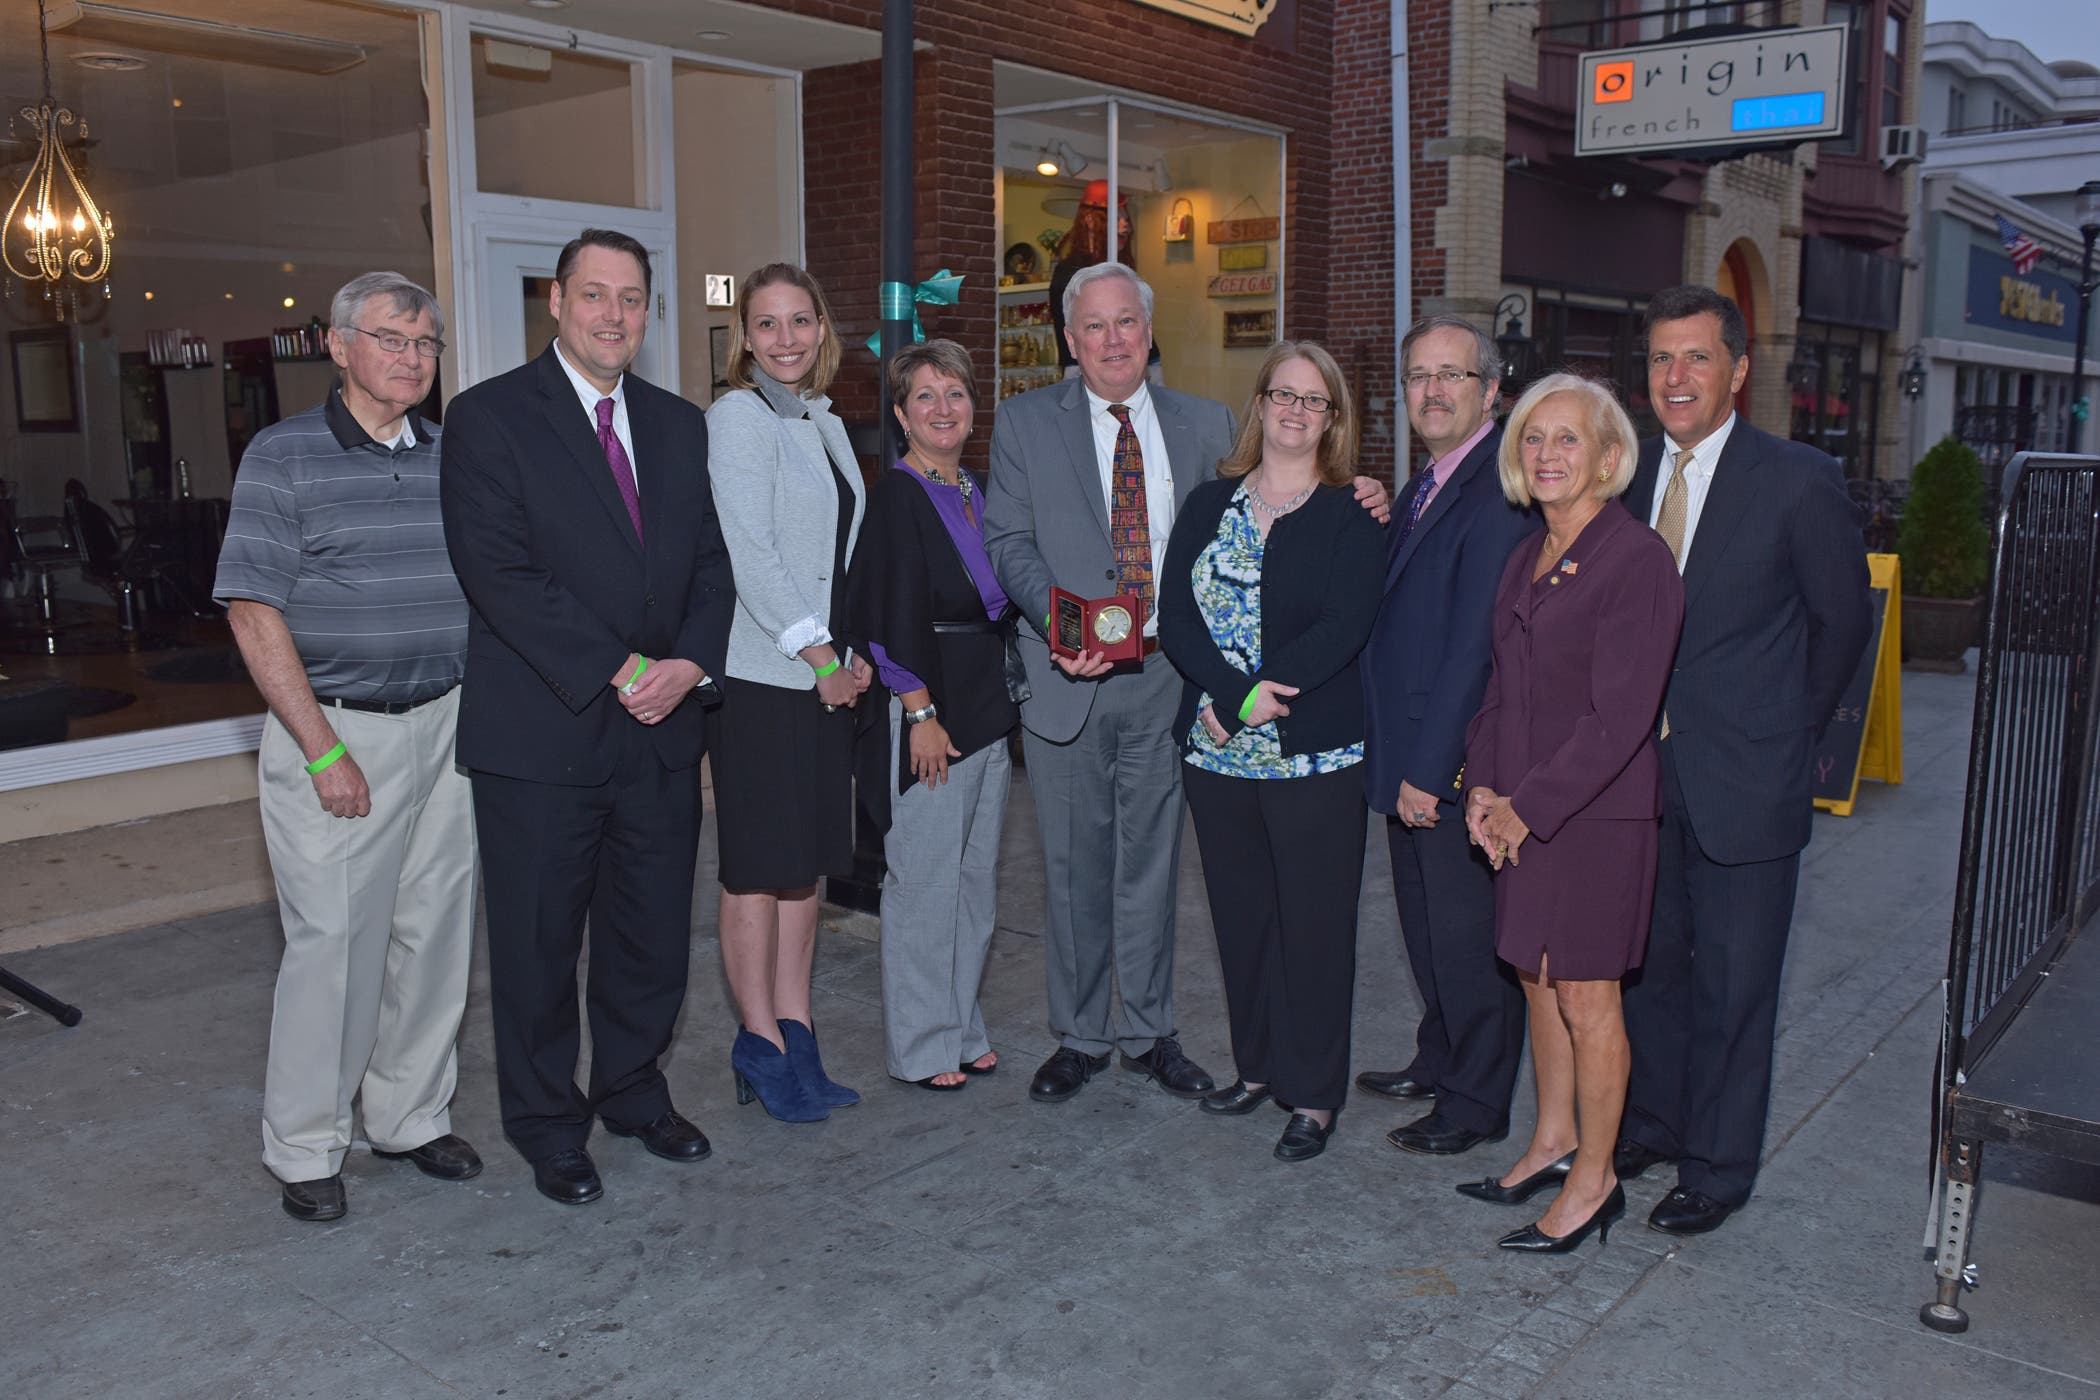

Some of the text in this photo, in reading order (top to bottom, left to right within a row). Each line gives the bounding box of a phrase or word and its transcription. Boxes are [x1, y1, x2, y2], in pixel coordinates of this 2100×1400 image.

[1602, 44, 1810, 96] origin
[1591, 99, 1816, 140] french thai
[1230, 221, 1276, 239] STOP
[708, 276, 730, 304] 21
[1219, 275, 1272, 292] GET GAS
